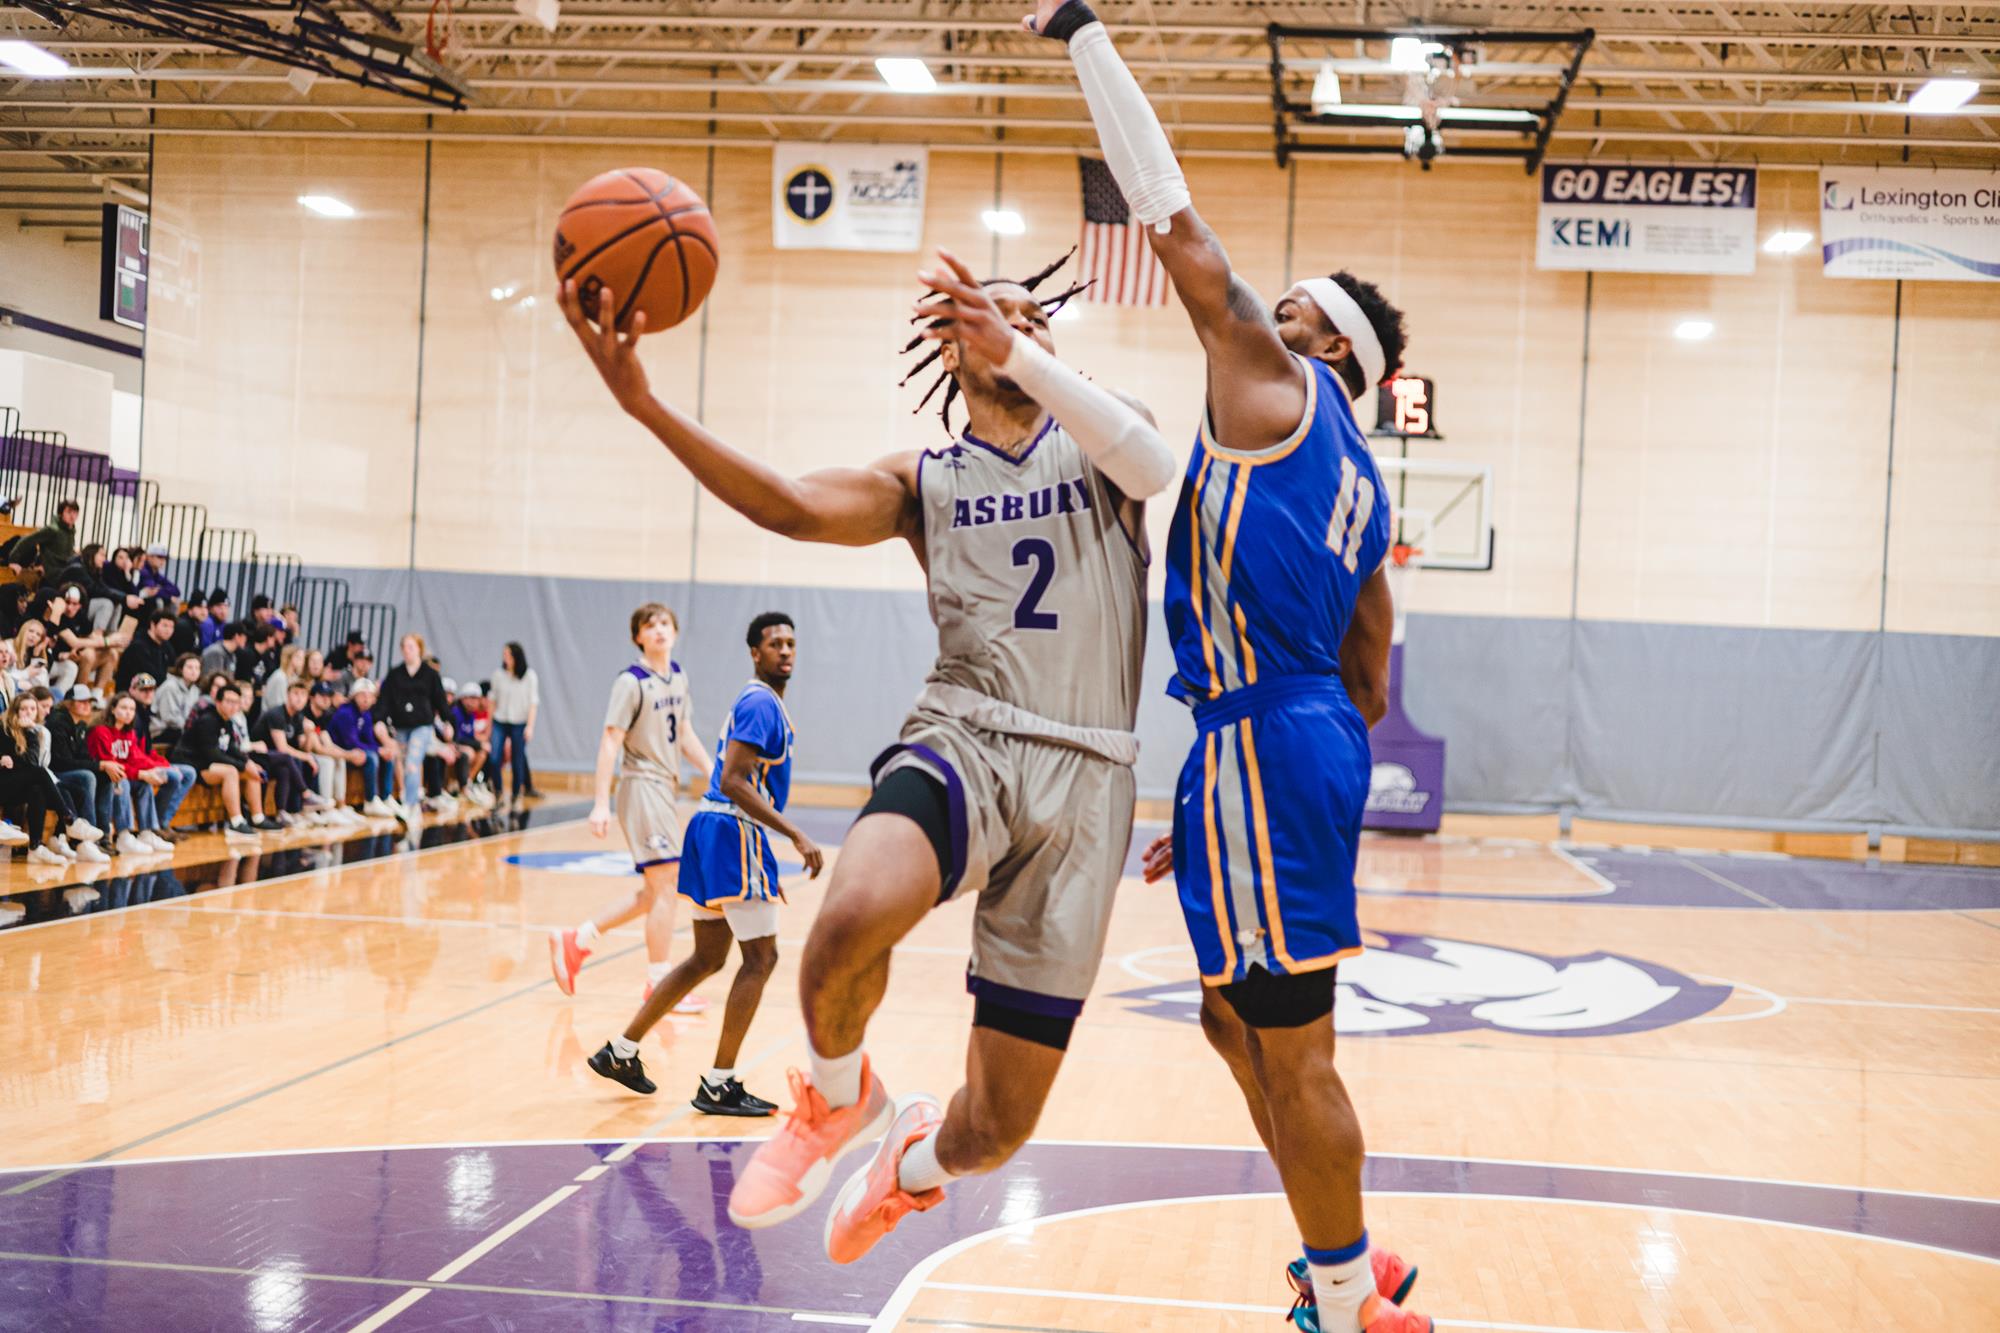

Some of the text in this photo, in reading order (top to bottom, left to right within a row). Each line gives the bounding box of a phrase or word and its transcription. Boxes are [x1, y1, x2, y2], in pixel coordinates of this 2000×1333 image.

[1551, 169, 1747, 203] GO EAGLES!
[1861, 187, 1966, 209] Lexington
[1552, 217, 1631, 247] KEMI
[1860, 212, 1929, 224] Orthopedics
[1943, 215, 1979, 226] Sports
[1326, 456, 1375, 574] 11
[1012, 538, 1058, 630] 2
[667, 713, 677, 743] 3
